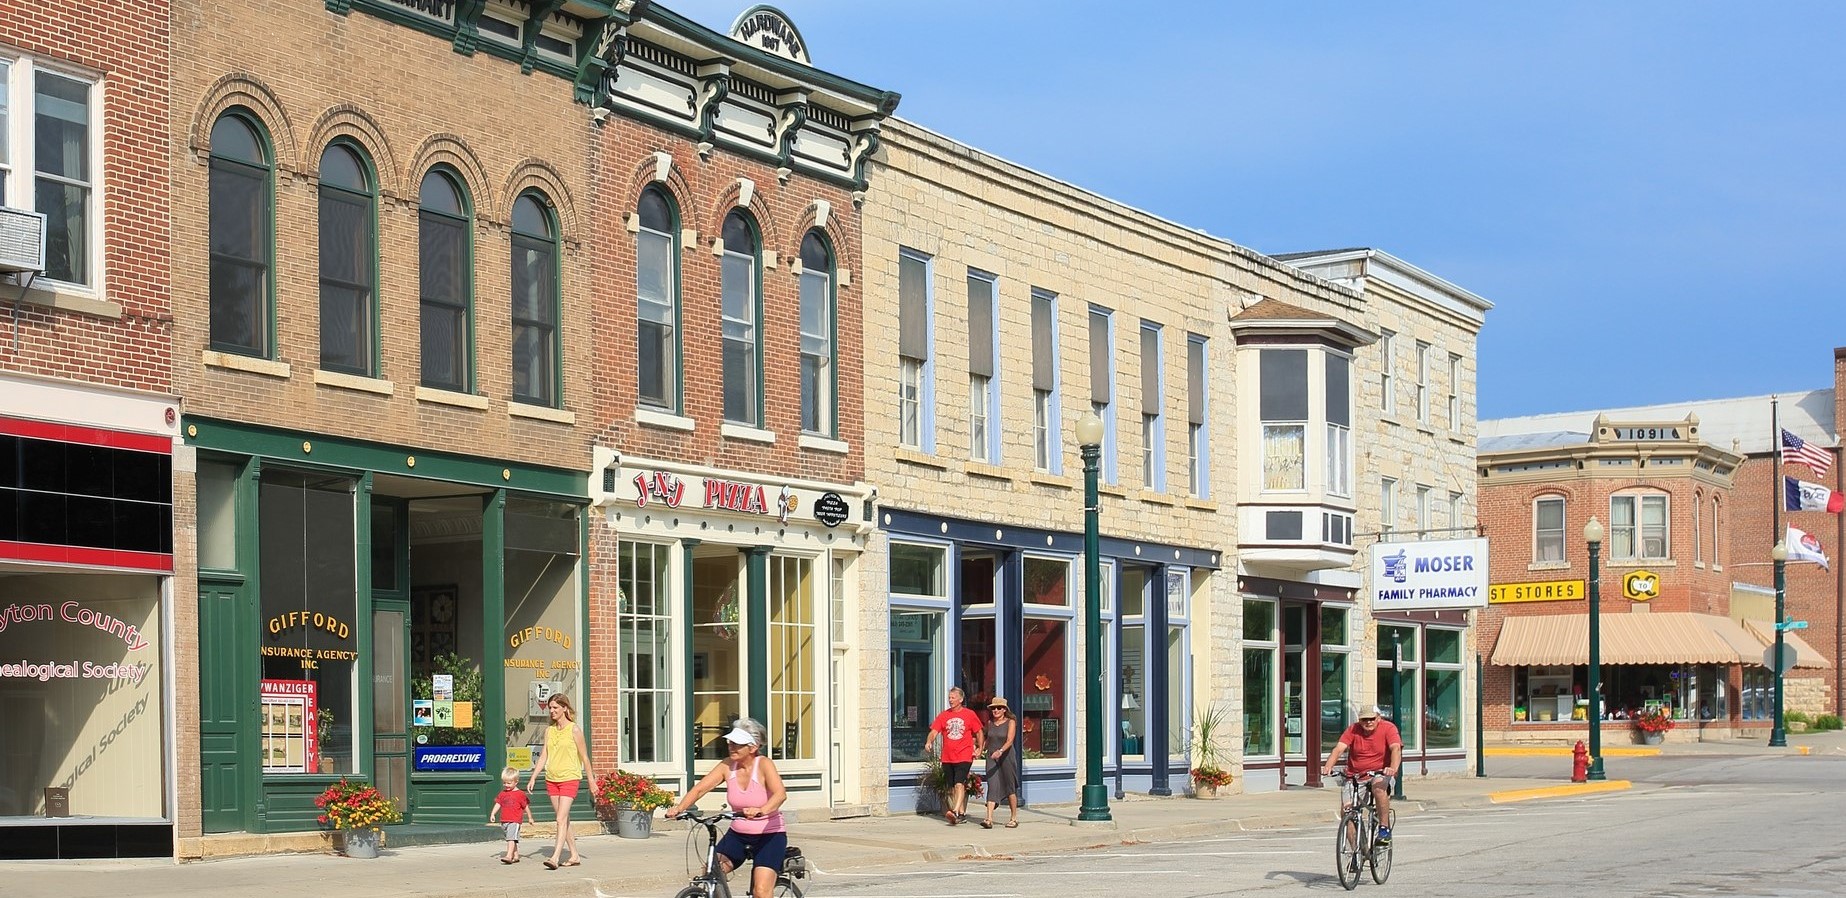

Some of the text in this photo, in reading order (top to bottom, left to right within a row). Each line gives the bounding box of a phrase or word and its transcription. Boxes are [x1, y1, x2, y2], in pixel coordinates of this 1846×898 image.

[741, 14, 801, 59] HARDWARE
[702, 477, 769, 515] PIZZA
[1414, 555, 1474, 573] MOSER
[1378, 586, 1478, 600] FAMILY PHARMACY
[1516, 585, 1574, 599] STORES
[60, 600, 150, 651] County
[269, 611, 349, 639] GIFFORD
[510, 626, 572, 649] GIFFORD
[316, 649, 357, 661] AGENCY
[551, 660, 581, 670] AGENCY
[0, 660, 145, 682] ealogical Society
[420, 753, 482, 764] PROGRESSIVE
